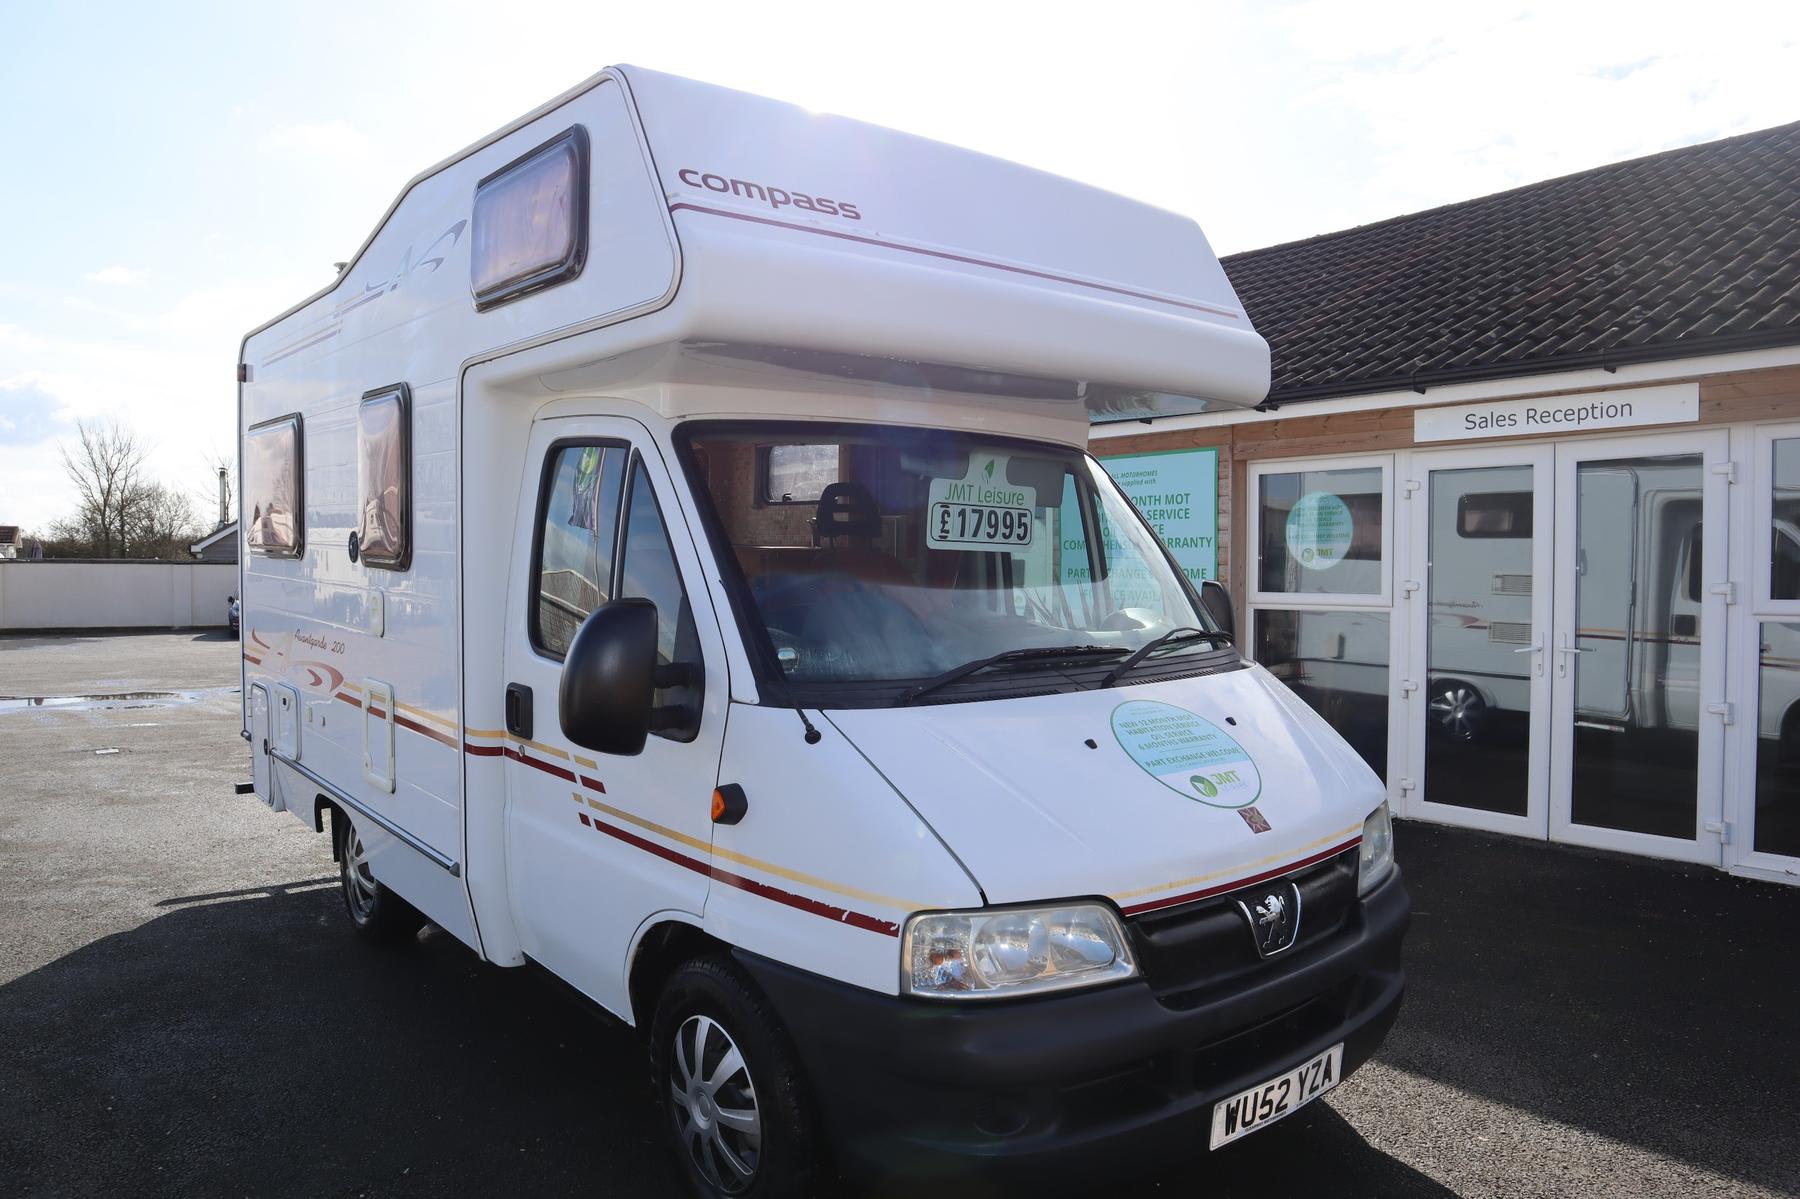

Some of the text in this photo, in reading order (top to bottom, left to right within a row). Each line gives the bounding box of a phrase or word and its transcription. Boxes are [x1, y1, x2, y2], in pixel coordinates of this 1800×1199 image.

[678, 169, 862, 220] compass
[1465, 402, 1633, 430] Sales Reception
[944, 483, 1025, 506] JMT Leisure
[1131, 493, 1191, 507] ONTH MOT
[938, 504, 1029, 541] £17995
[1147, 508, 1190, 520] SERVICE
[1161, 536, 1213, 549] RRANTY
[331, 640, 345, 655] 200
[1225, 1053, 1332, 1136] WU52 YZA
